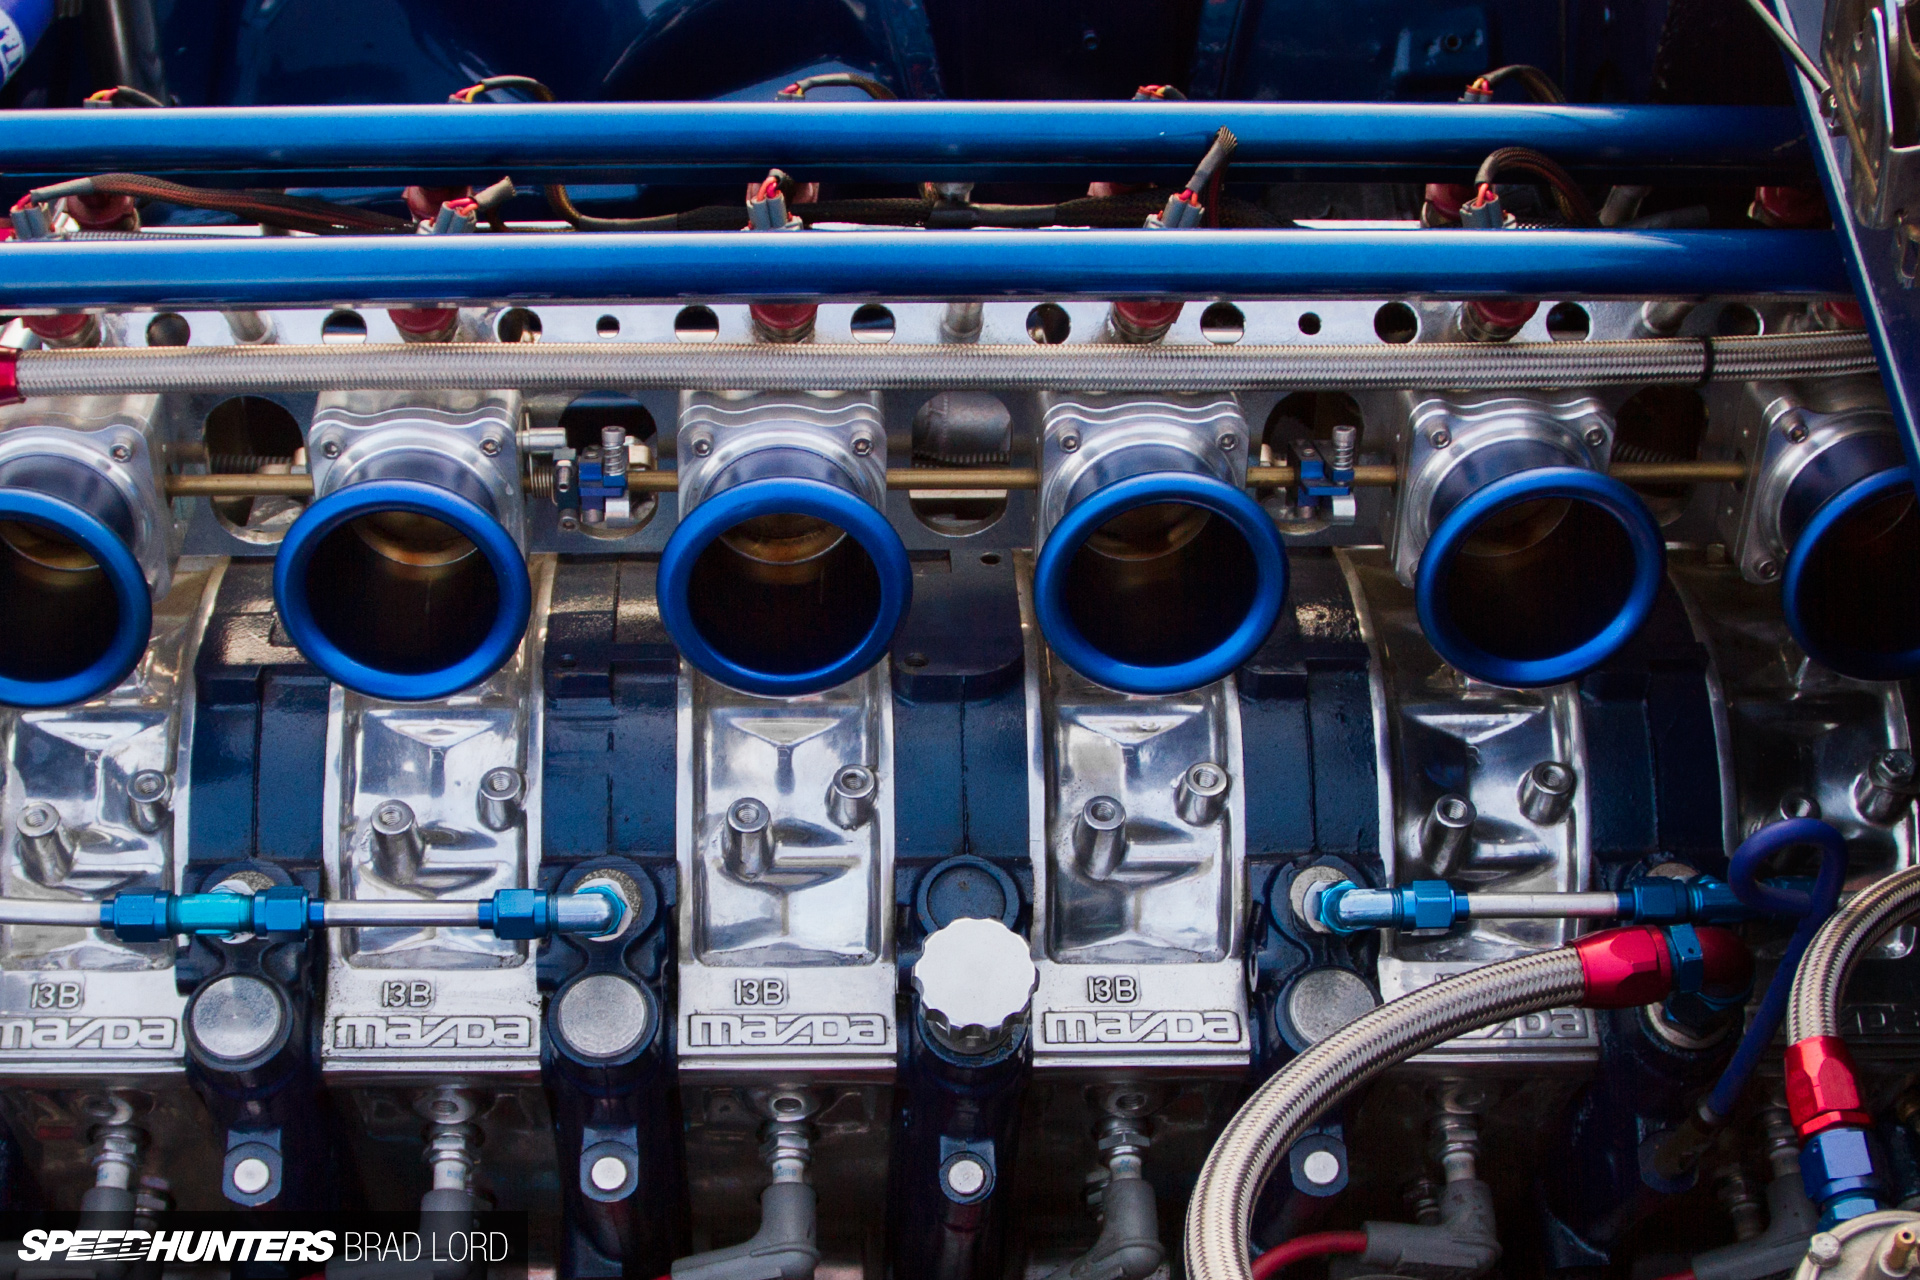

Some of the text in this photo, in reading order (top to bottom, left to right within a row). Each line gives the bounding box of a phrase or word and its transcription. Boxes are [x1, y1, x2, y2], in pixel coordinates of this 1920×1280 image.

[31, 982, 81, 1009] 13B
[382, 980, 432, 1007] 13B
[734, 978, 785, 1005] 13B
[1087, 975, 1137, 1003] 13B
